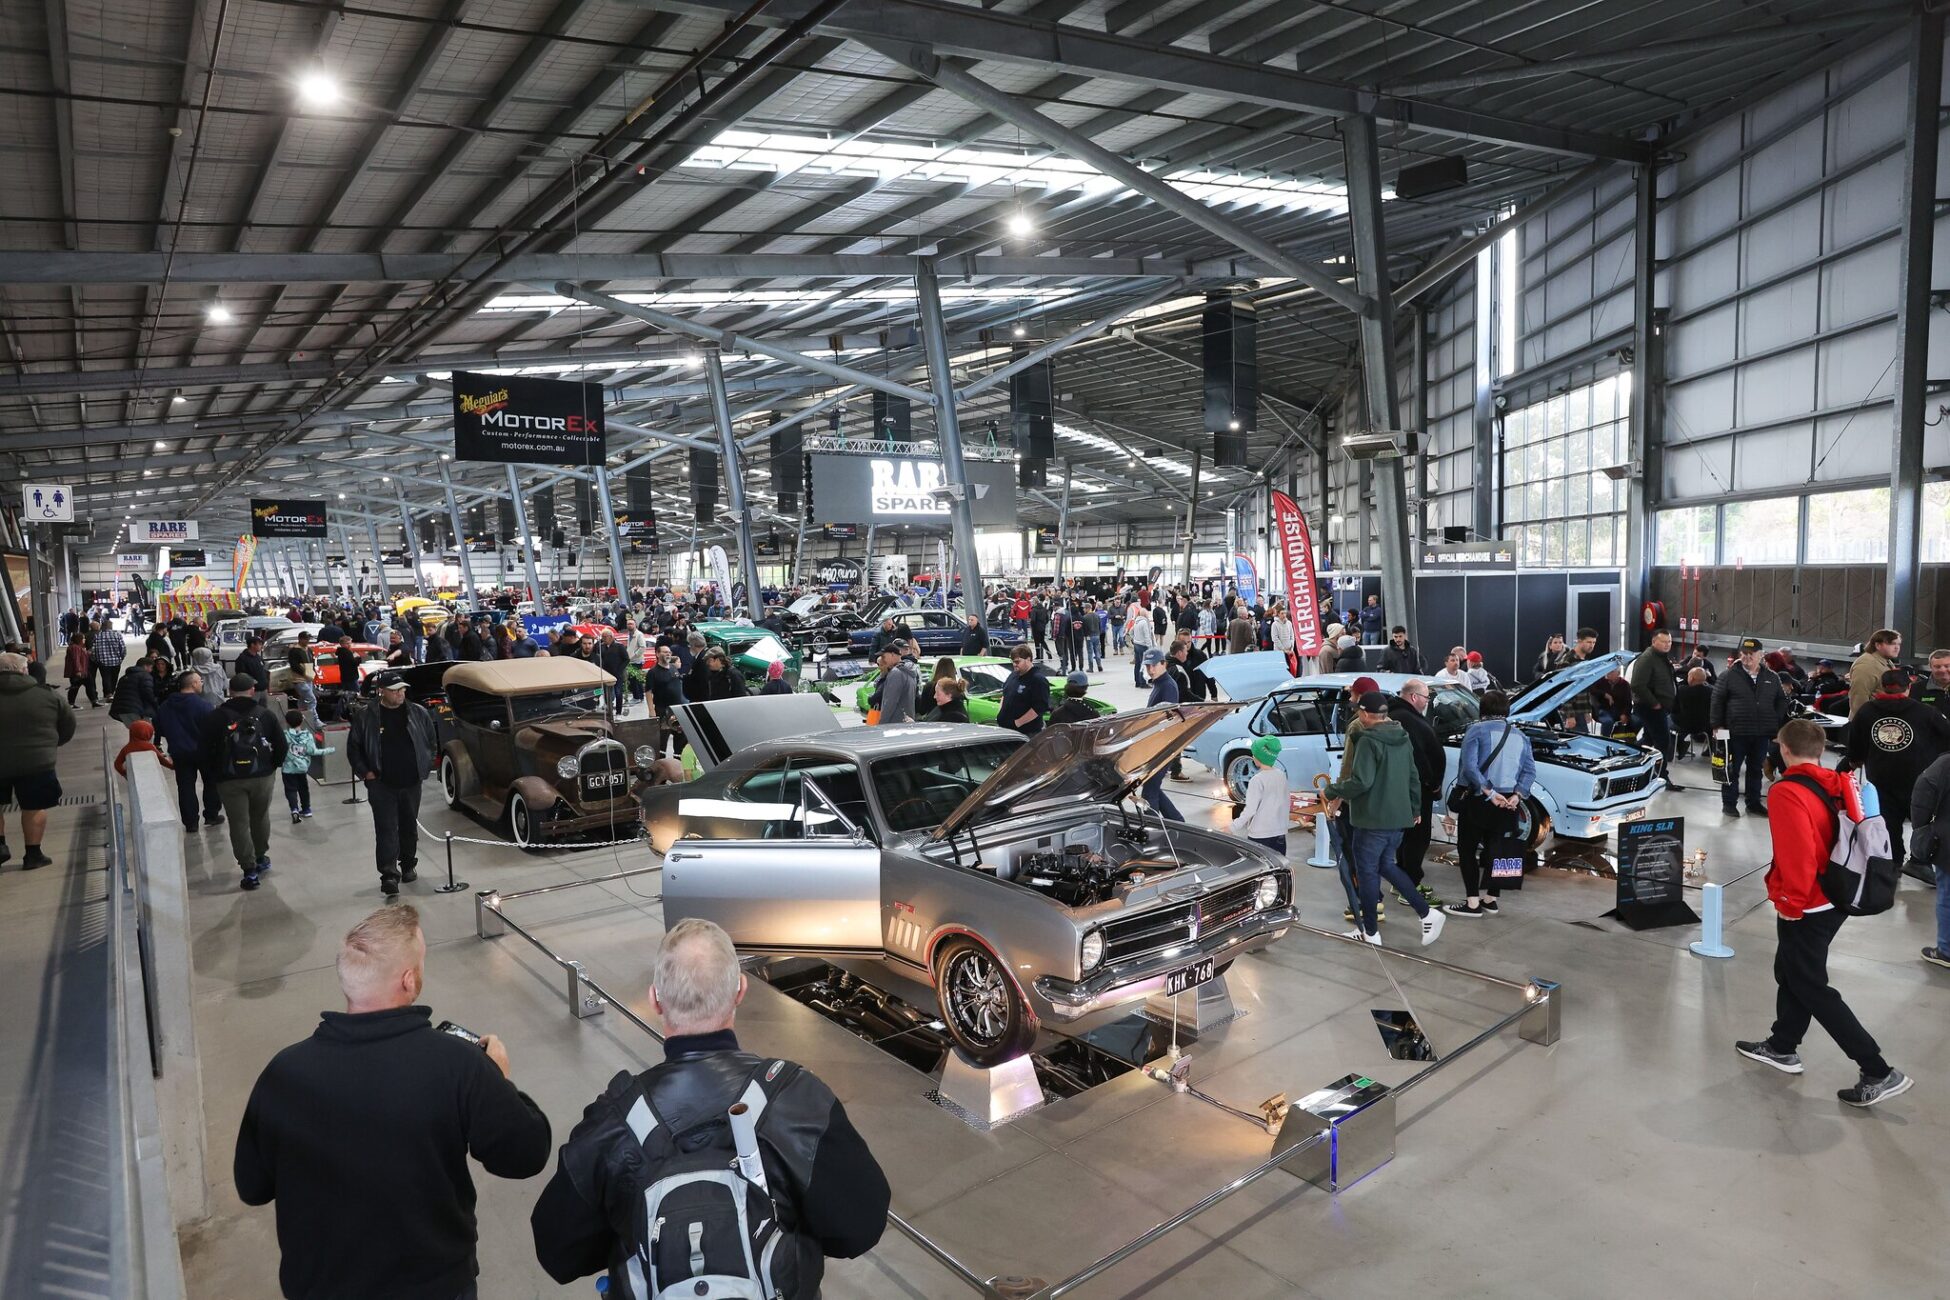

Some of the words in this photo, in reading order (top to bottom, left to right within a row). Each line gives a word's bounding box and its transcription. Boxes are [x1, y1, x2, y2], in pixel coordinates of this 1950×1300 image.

[459, 388, 509, 414] Meguiar's
[482, 429, 509, 437] Custom
[513, 431, 558, 440] Performance
[562, 434, 600, 442] Collectable
[501, 442, 565, 452] motorex.com.au
[148, 522, 187, 532] RARE
[1282, 510, 1317, 650] MERCHANDISE
[1629, 823, 1654, 834] KING
[1655, 821, 1675, 832] SLR
[1493, 857, 1523, 870] RARE
